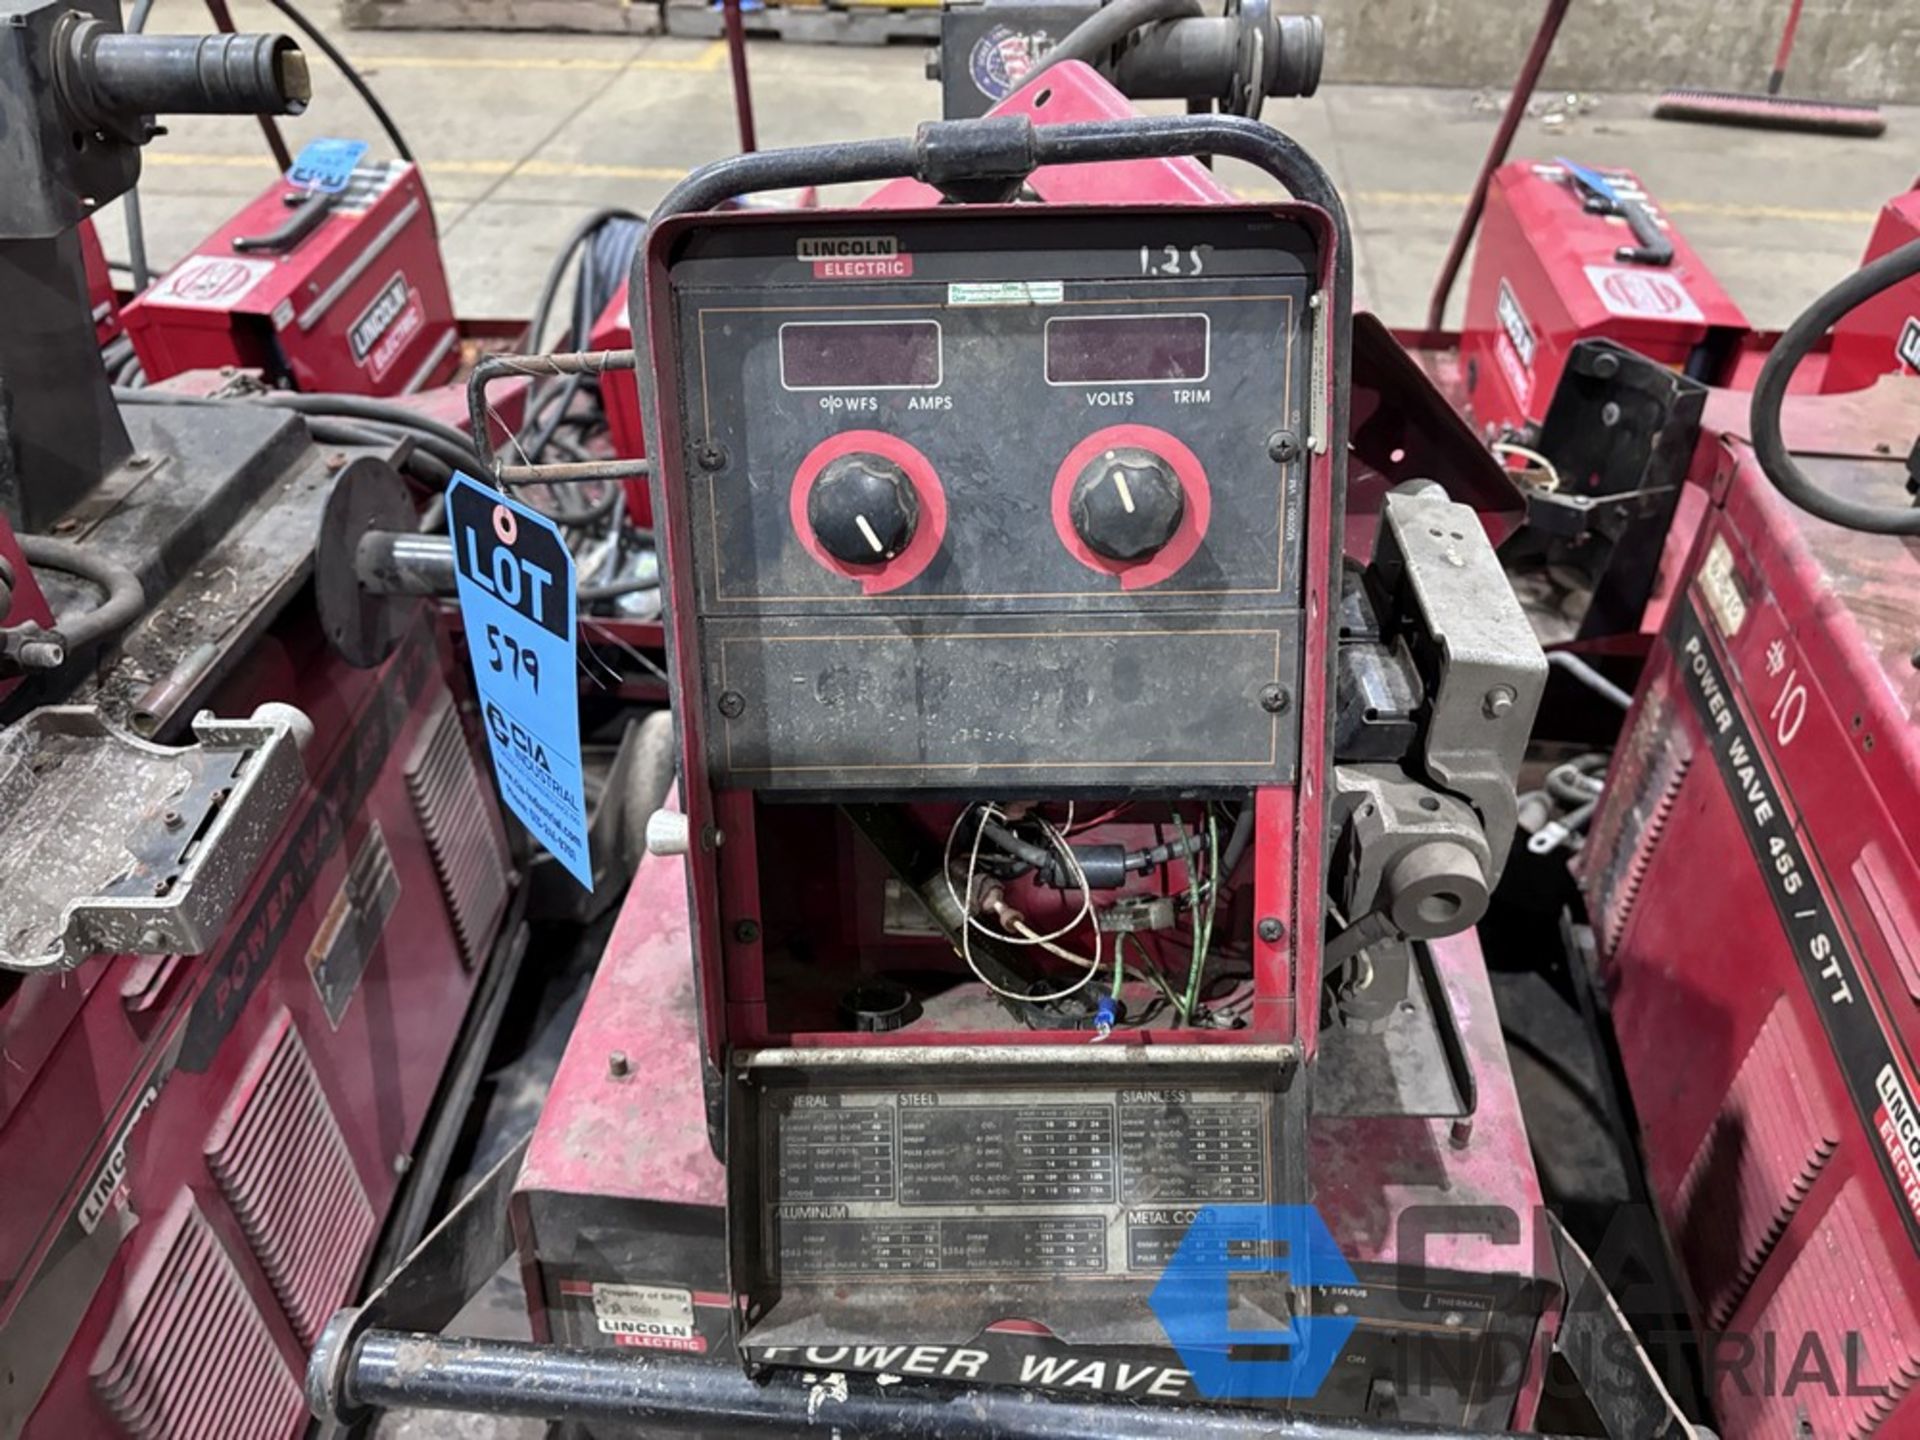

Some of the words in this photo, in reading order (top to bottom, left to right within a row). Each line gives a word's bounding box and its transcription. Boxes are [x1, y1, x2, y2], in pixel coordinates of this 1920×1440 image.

[802, 239, 892, 257] LINCOLN
[824, 261, 904, 276] ELECTRIC
[908, 396, 953, 410] AMPS
[1086, 391, 1135, 406] VOLTS
[1173, 389, 1211, 403] TRIM
[465, 525, 552, 622] LOT
[486, 624, 540, 696] 579
[510, 721, 552, 774] CIA
[514, 746, 581, 813] INDUSTRIAL
[1685, 636, 1734, 733] POWER
[1729, 736, 1774, 827] WAVE
[1768, 836, 1803, 895] 455
[1810, 934, 1854, 1004] STT
[900, 1093, 935, 1106] STEEL
[1122, 1090, 1186, 1103] STAINLESS
[1880, 1074, 1920, 1171] LINCO
[776, 1205, 847, 1219] ALUMINUM
[1128, 1210, 1169, 1224] METAL
[1331, 1287, 1368, 1299] STATUS
[603, 1320, 687, 1337] LINCOLN
[624, 1335, 700, 1351] ELECTRIC
[1019, 1353, 1196, 1397] WAVE
